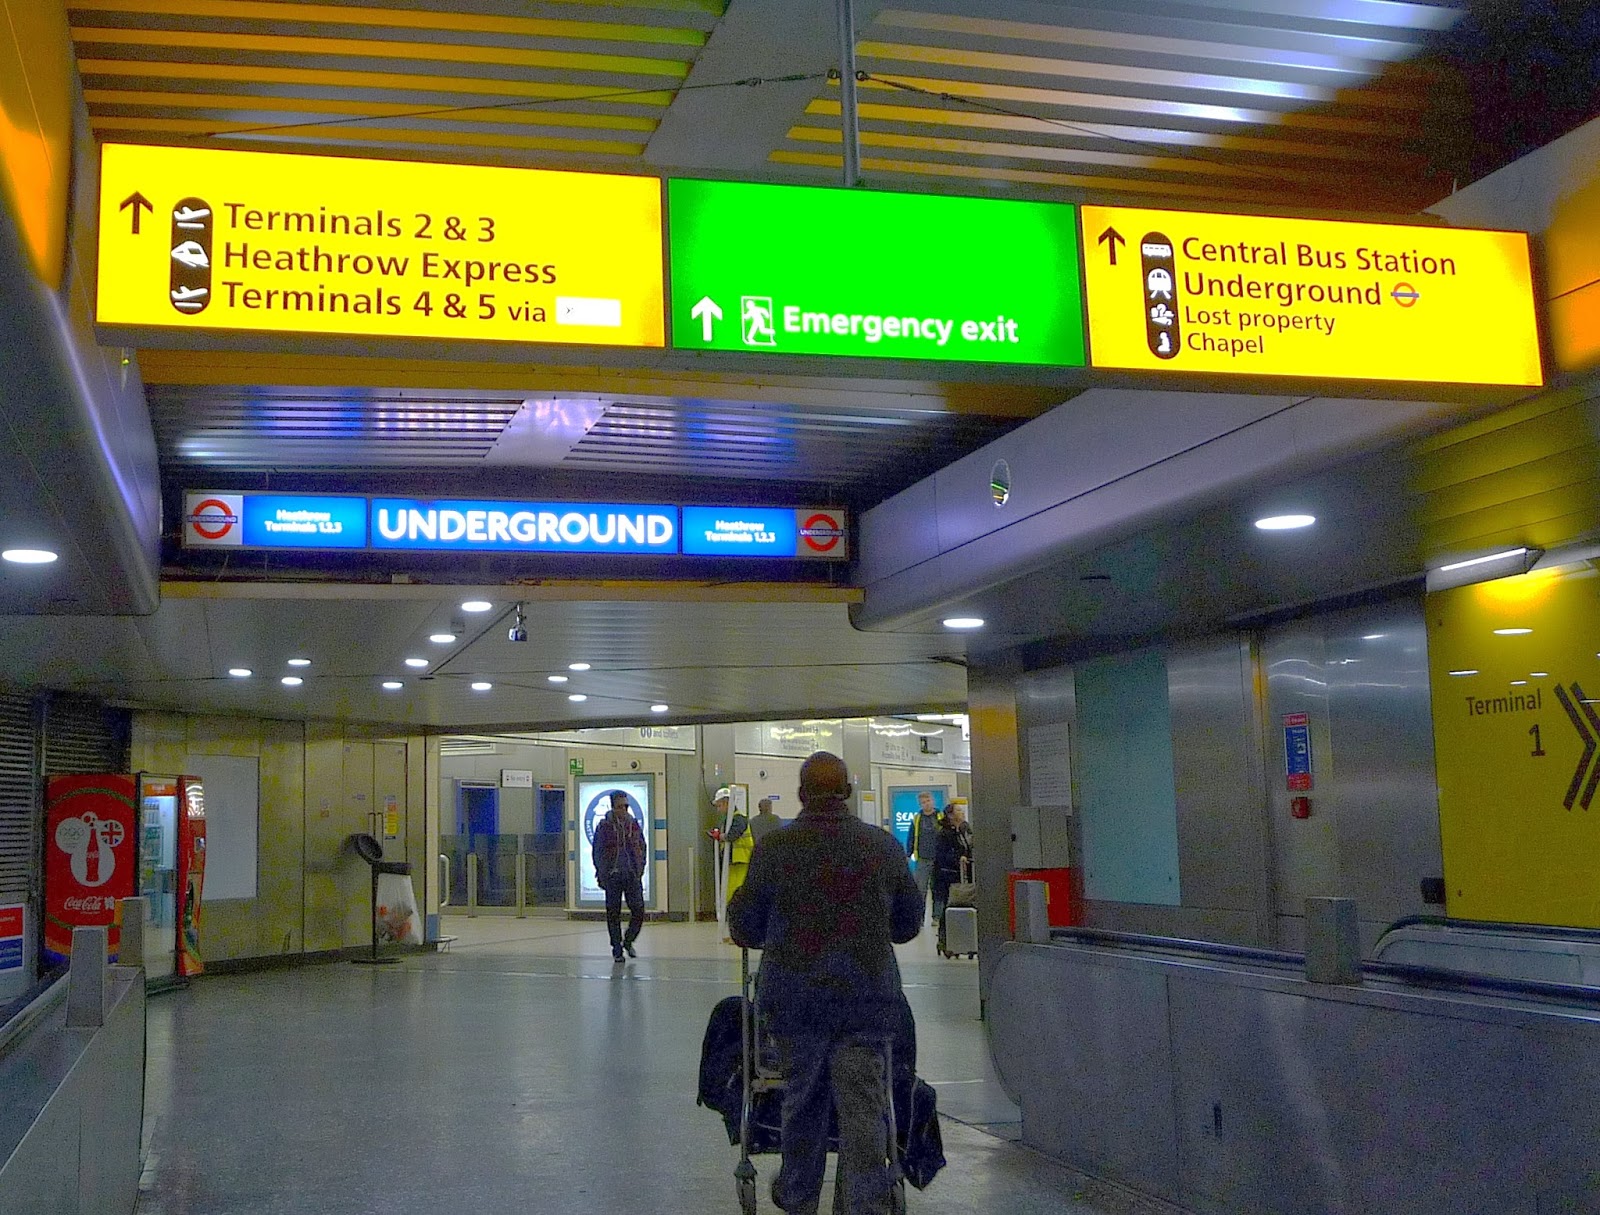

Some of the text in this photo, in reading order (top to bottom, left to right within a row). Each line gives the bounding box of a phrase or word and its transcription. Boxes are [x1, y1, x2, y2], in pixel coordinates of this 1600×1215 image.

[224, 203, 495, 243] Terminals 2 & 3
[225, 243, 557, 288] Heathrow Express
[1183, 238, 1456, 276] Central Bus Station
[222, 282, 546, 323] Terminals 4 & 5 via
[1185, 272, 1381, 307] Underground
[784, 306, 1020, 346] Emergency exit
[1186, 306, 1335, 336] Lost property
[1188, 333, 1264, 358] Chapel
[379, 509, 673, 544] UNDERGROUND
[799, 529, 842, 537] UNDERGROUND
[1466, 688, 1541, 716] Terminal
[1529, 724, 1546, 757] 1
